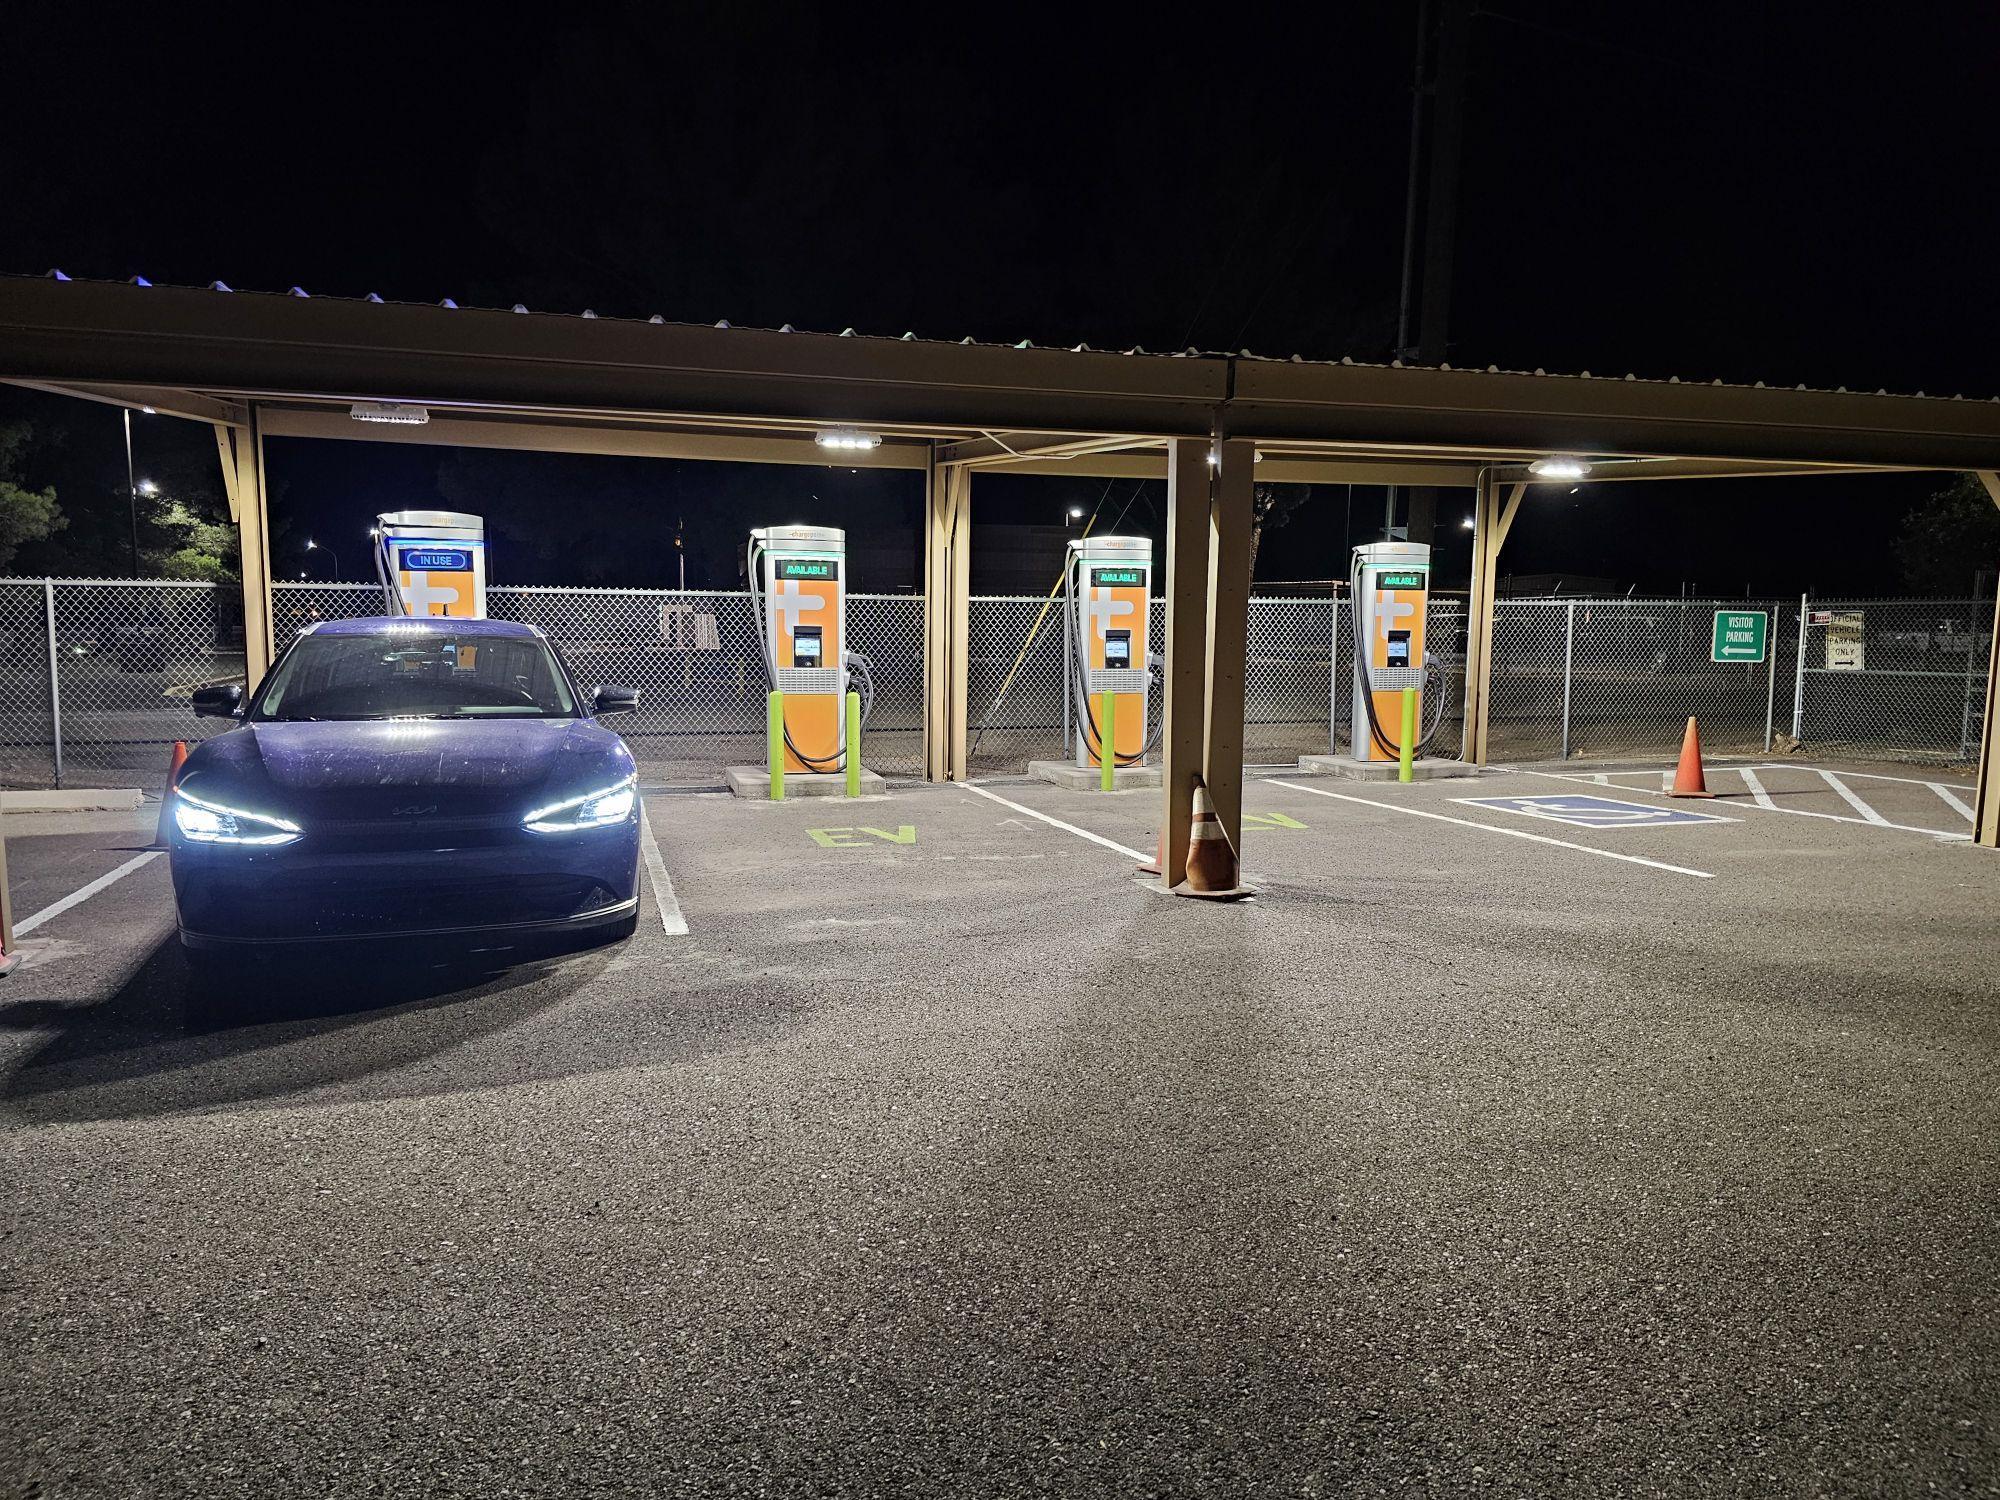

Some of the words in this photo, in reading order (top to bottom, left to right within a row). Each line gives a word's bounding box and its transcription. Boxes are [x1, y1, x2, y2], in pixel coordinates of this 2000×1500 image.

[420, 555, 433, 565] IN
[433, 555, 452, 566] USE
[786, 565, 828, 576] AVAILABLE
[1100, 573, 1137, 583] AVAILABLE
[1384, 576, 1418, 586] AVAILABLE
[1728, 616, 1754, 629] VISITOR
[1830, 625, 1860, 634] VEHICLE
[1725, 631, 1754, 643] PARKING
[1829, 637, 1861, 645] PARKING
[1835, 648, 1855, 656] ONLY
[804, 825, 916, 848] EV
